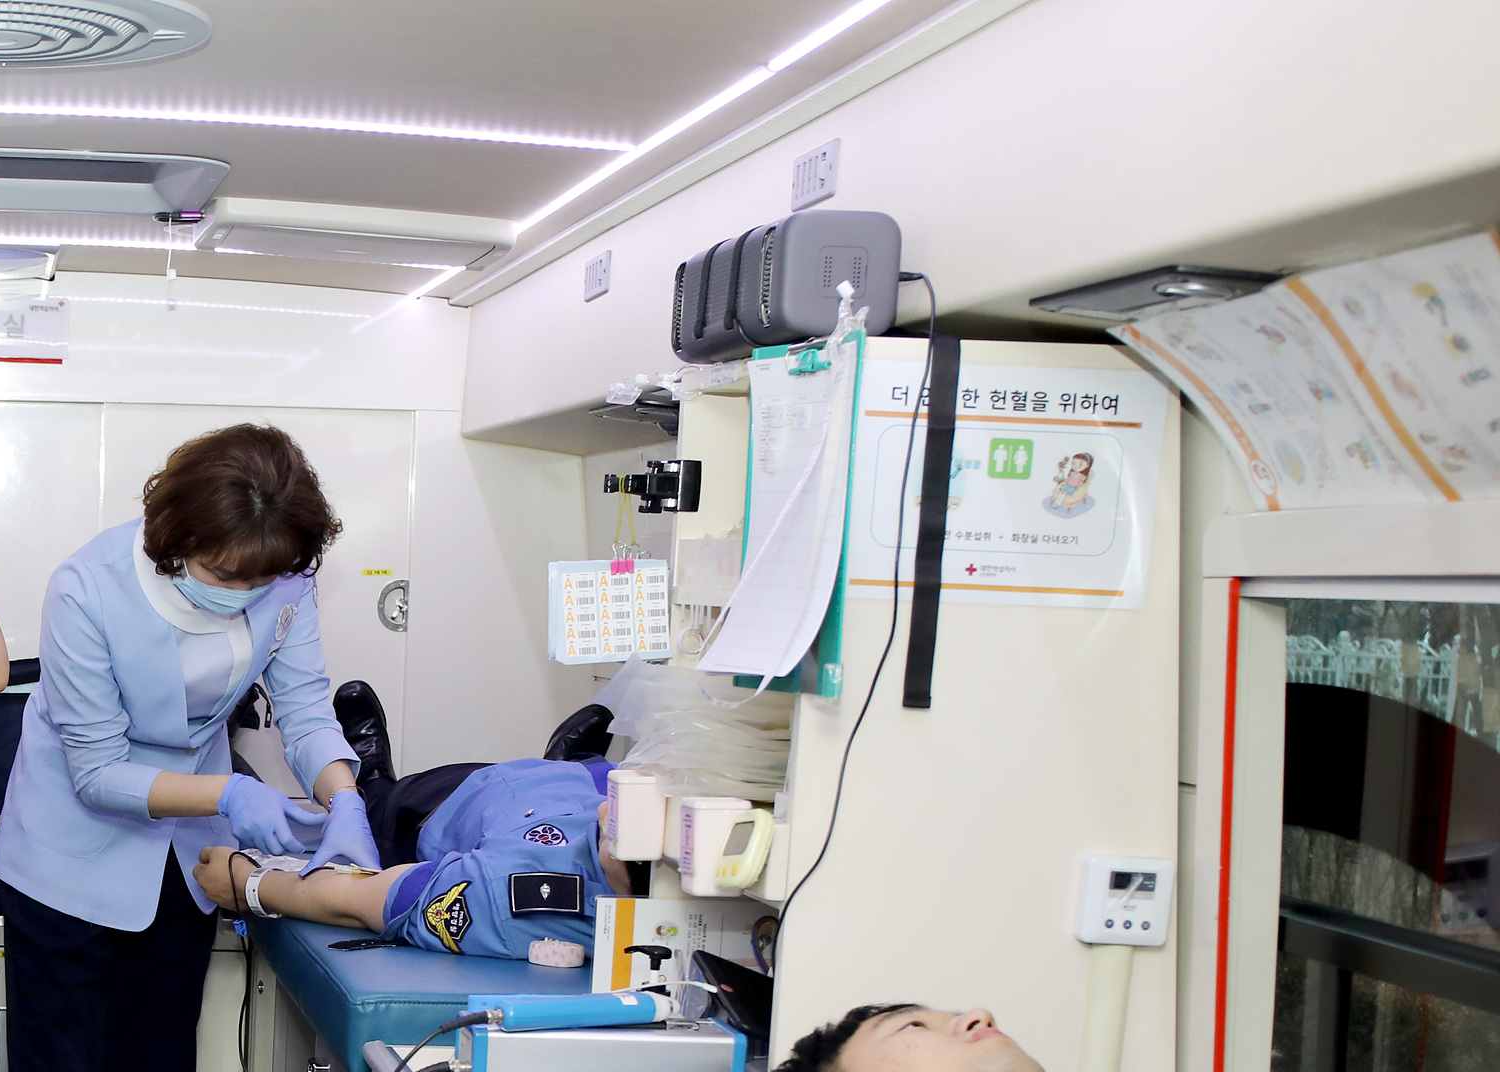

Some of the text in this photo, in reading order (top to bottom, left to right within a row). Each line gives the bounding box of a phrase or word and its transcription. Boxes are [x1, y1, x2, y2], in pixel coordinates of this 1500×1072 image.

[891, 385, 909, 407] 더
[990, 388, 1050, 413] 헌혈을
[1059, 392, 1120, 415] 위하여
[564, 578, 573, 589] A
[600, 576, 608, 586] A
[635, 573, 644, 584] A
[565, 595, 573, 605] A
[600, 592, 609, 603] A
[636, 590, 644, 600] A
[566, 612, 574, 622] A
[601, 609, 610, 620] A
[636, 607, 645, 617] A
[567, 628, 575, 639] A
[602, 626, 610, 636] A
[637, 624, 646, 634] A
[568, 645, 576, 655] A
[603, 642, 612, 653] A
[638, 640, 647, 651] A
